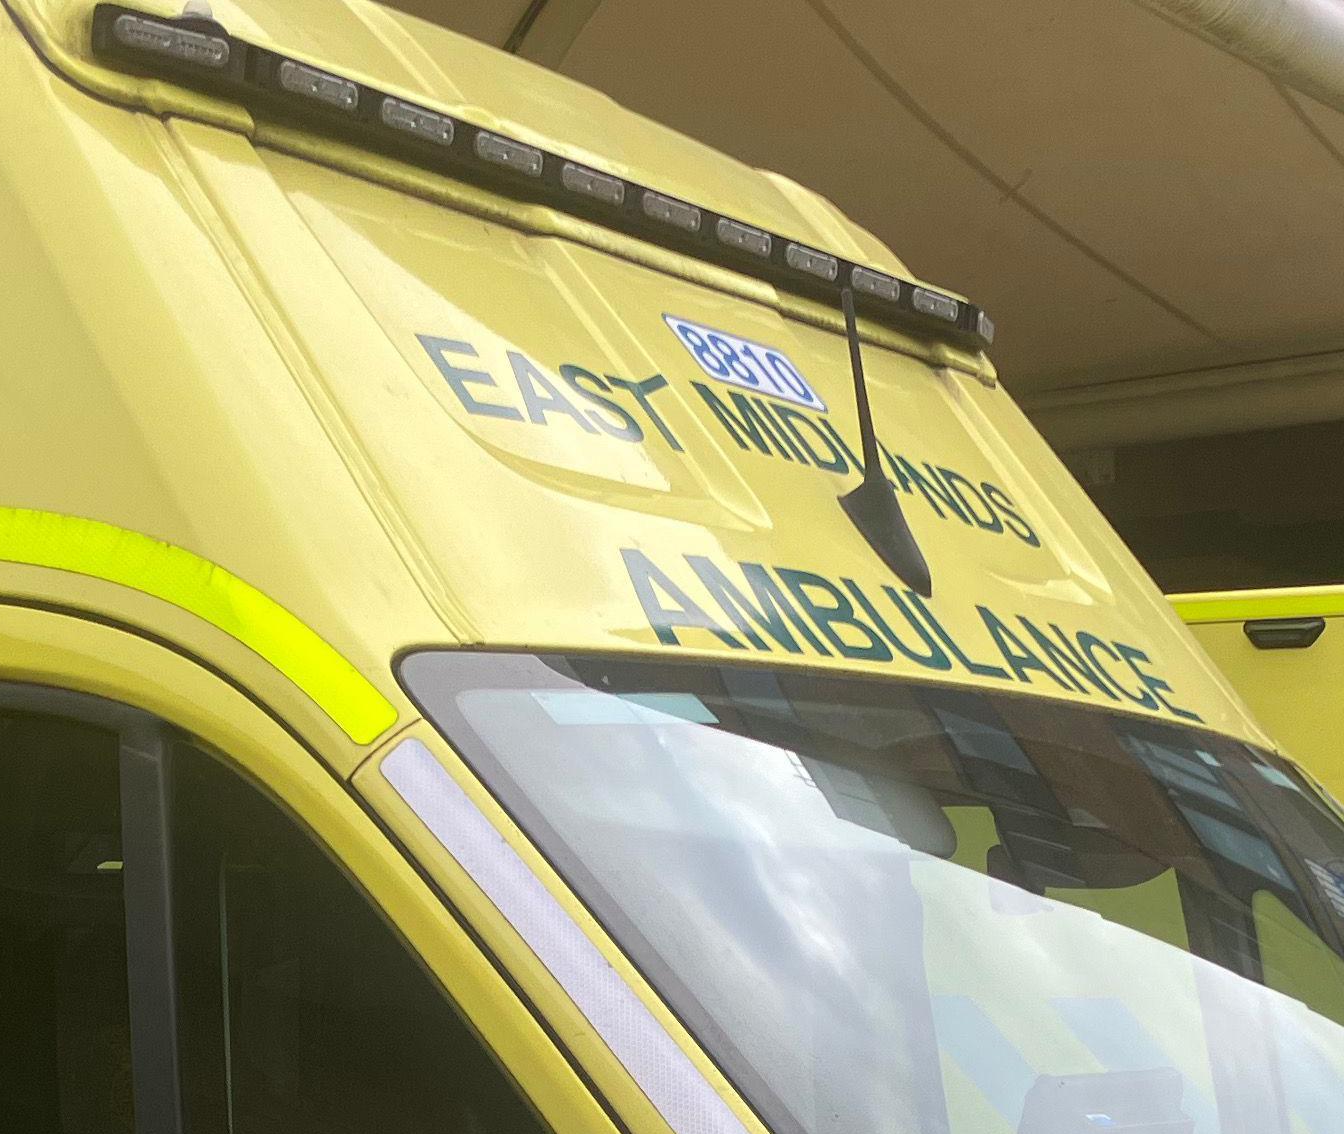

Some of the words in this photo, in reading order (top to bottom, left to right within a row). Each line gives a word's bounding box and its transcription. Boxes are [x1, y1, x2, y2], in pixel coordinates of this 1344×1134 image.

[414, 332, 686, 453] EAST
[676, 323, 814, 403] 8810
[619, 547, 1205, 724] AMBULANCE
